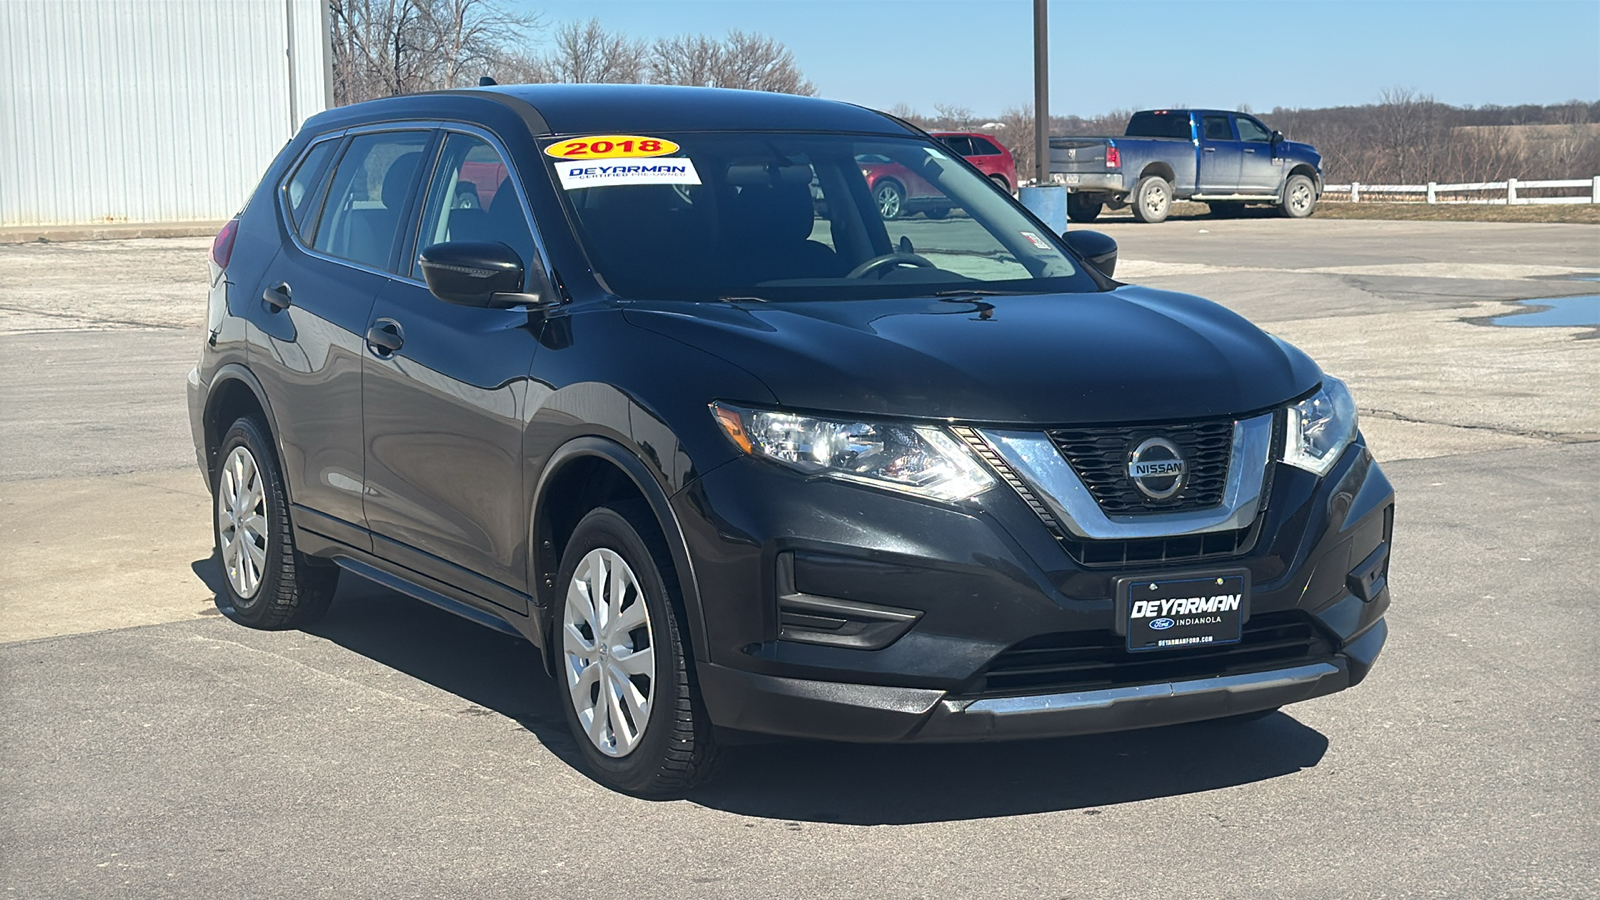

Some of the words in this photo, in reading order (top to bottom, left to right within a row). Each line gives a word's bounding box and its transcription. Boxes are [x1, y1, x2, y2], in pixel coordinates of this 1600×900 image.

[563, 140, 663, 156] 2018
[569, 165, 686, 177] DEYARMAN
[579, 172, 629, 180] CERTIFIED
[1136, 463, 1182, 474] NISSAN
[1131, 594, 1242, 619] DEYARMAN
[1153, 619, 1171, 628] Ford
[1176, 616, 1222, 626] INDIANOLA
[1158, 636, 1213, 647] DEYARMANFORD.COM
